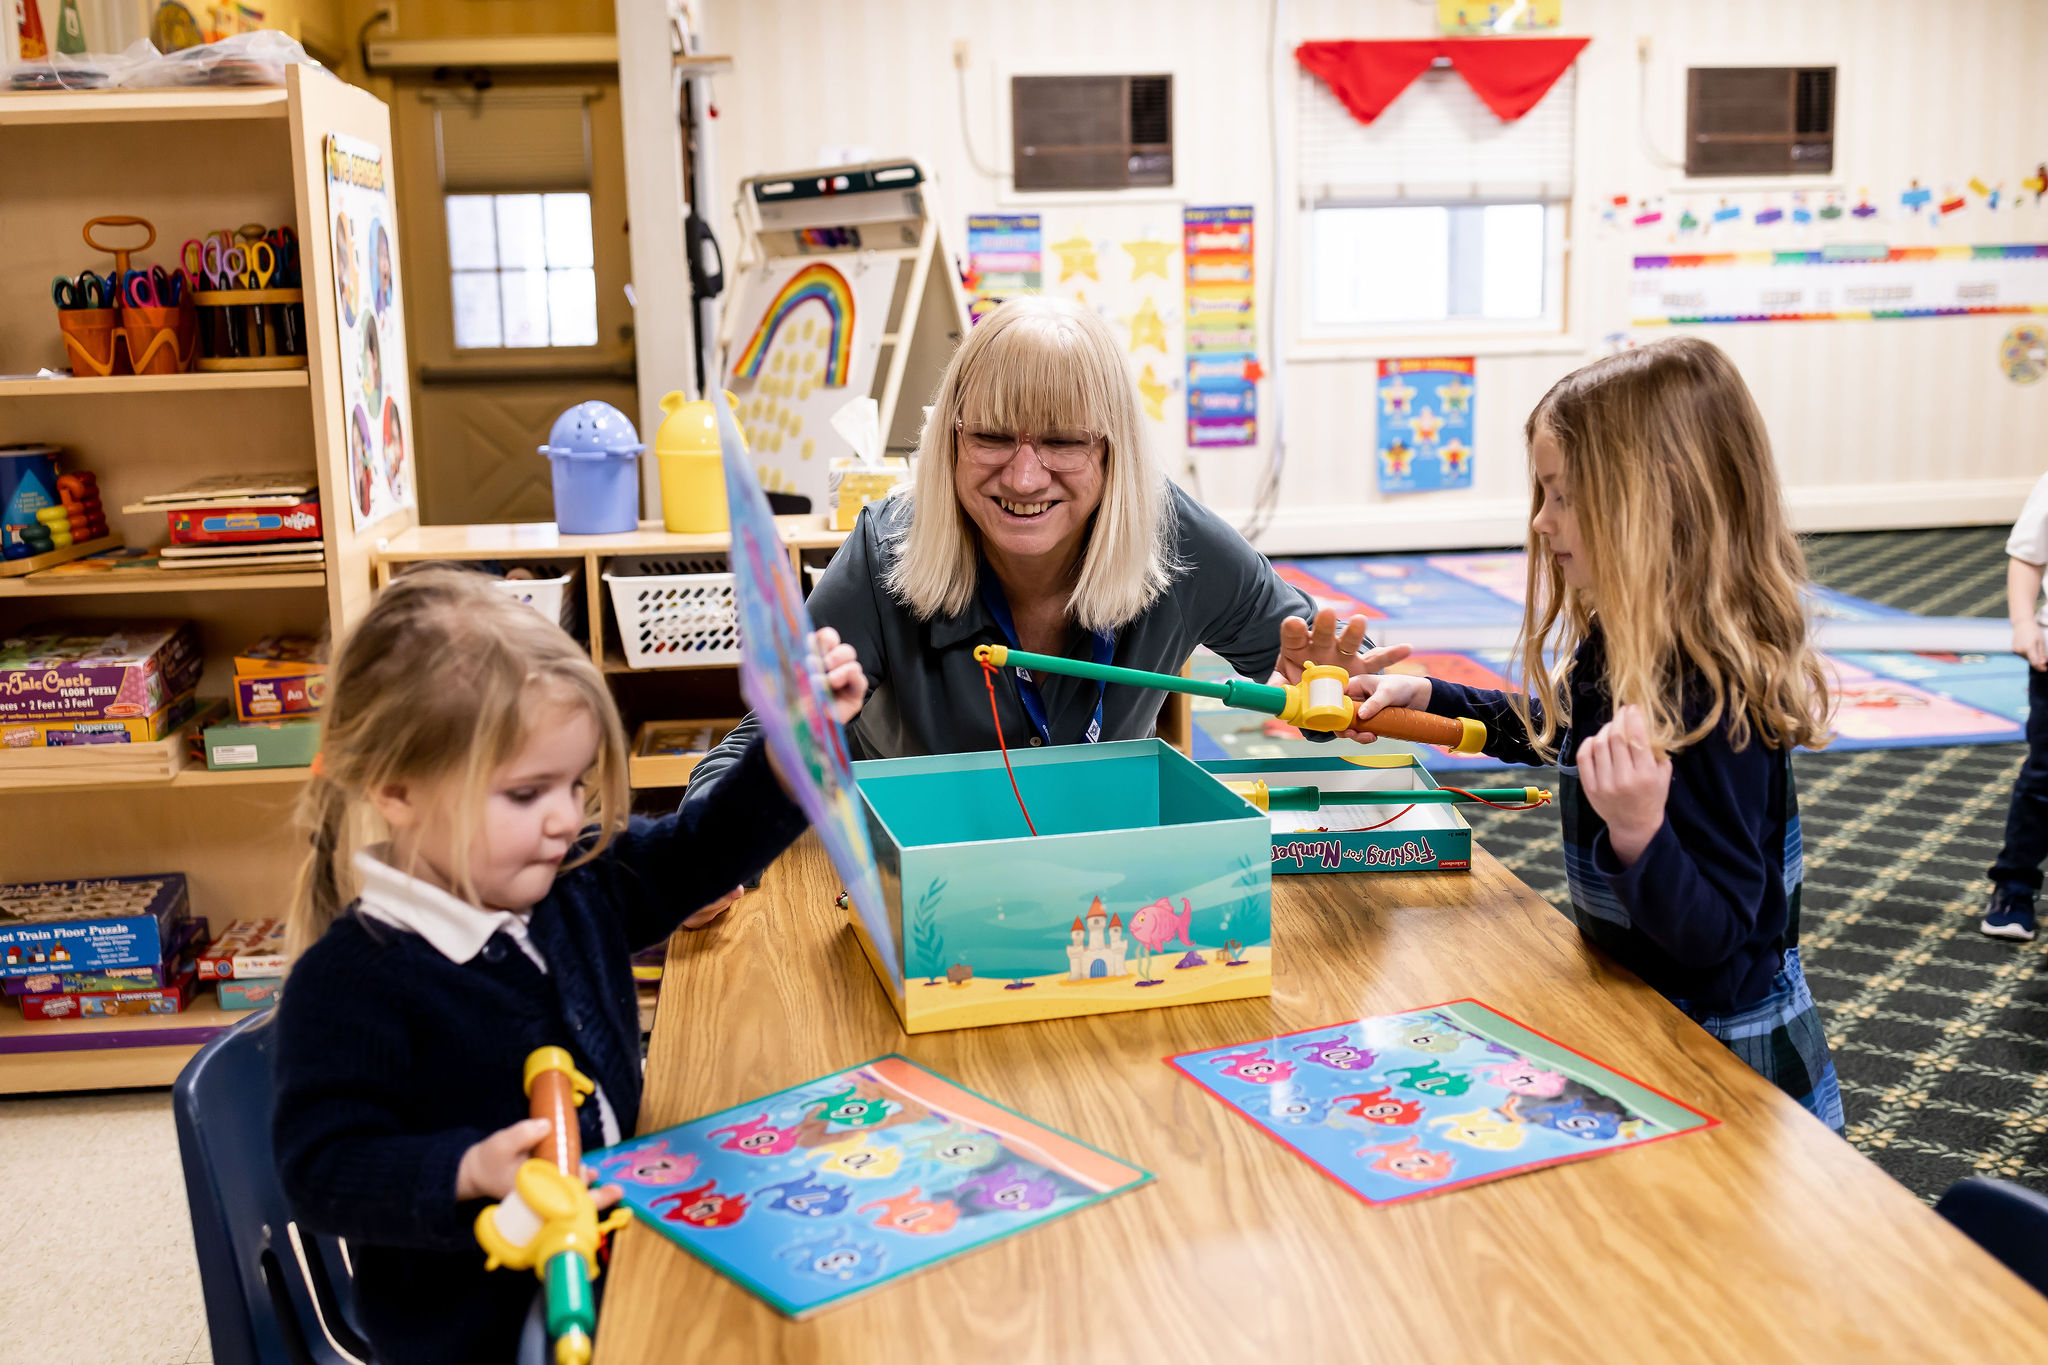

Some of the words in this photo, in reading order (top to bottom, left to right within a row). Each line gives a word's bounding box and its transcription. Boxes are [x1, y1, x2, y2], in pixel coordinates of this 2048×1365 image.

[61, 687, 85, 698] FLOOR
[88, 686, 118, 697] PUZZLE
[29, 701, 36, 710] 2
[38, 699, 55, 710] Feet
[65, 699, 70, 709] 3
[1343, 848, 1364, 862] for
[1365, 836, 1436, 866] Fishing
[17, 930, 52, 941] Train
[54, 927, 87, 939] Floor
[88, 923, 129, 937] Puzzle
